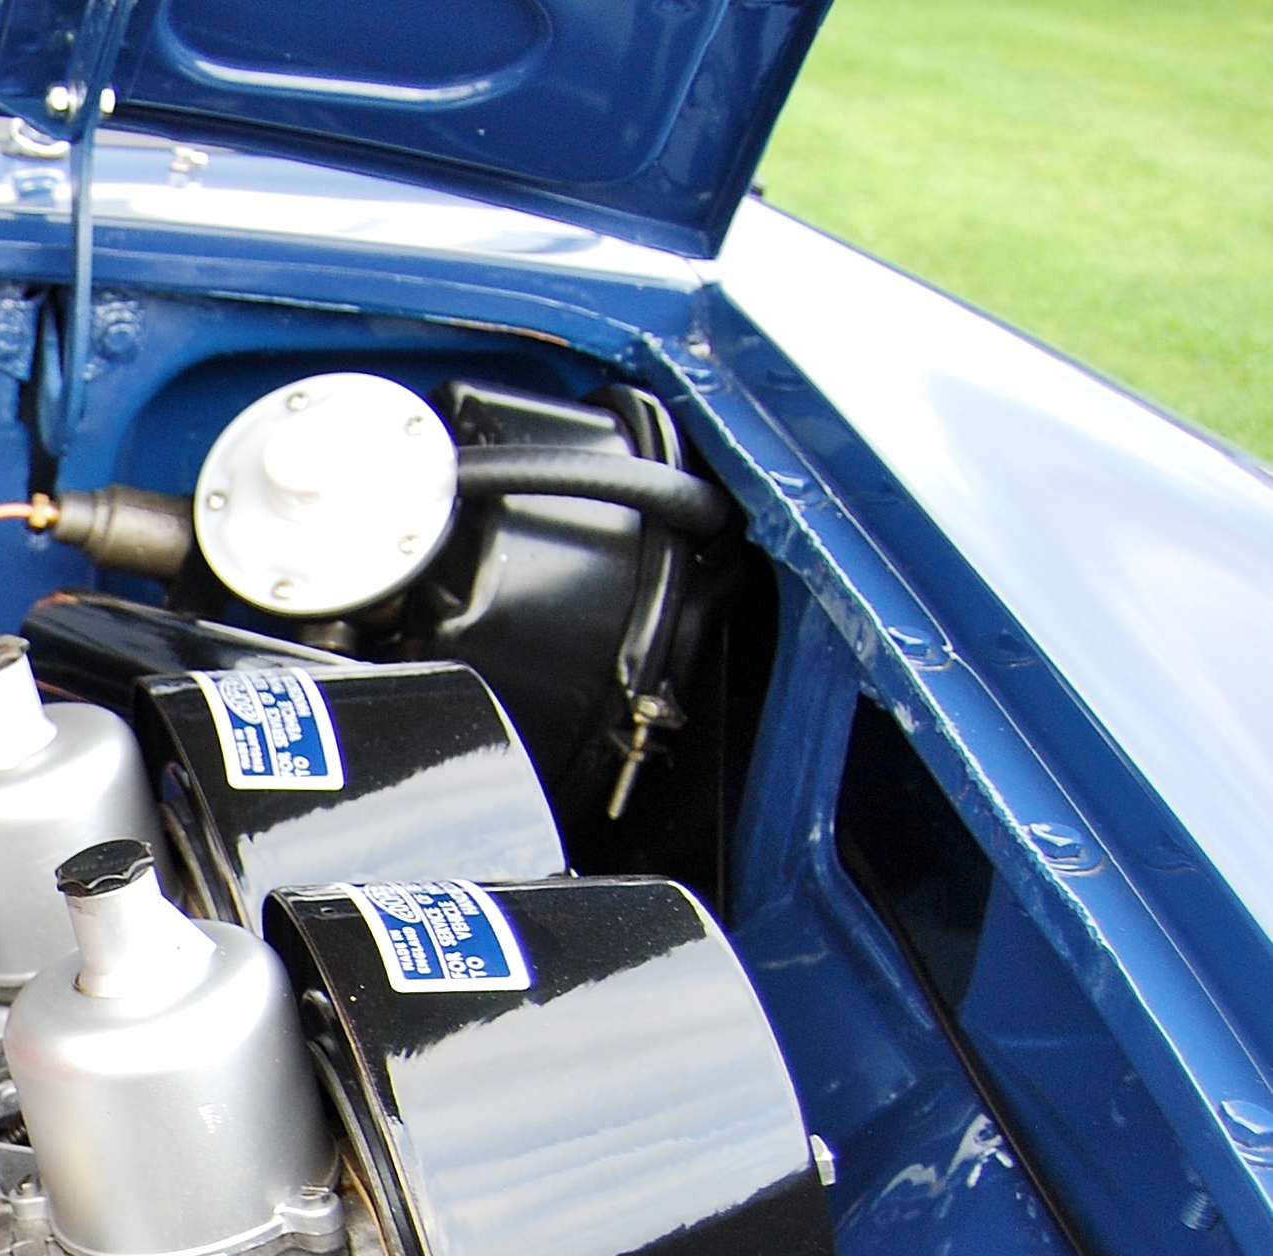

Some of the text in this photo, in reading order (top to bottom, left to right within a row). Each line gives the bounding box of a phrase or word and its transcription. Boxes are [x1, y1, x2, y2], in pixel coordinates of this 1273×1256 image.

[266, 706, 289, 748] SERVICE
[277, 699, 311, 777] TO VEHICLE
[413, 893, 434, 905] OF
[424, 906, 457, 948] SERVICE
[438, 900, 488, 979] TO VEHICLE
[402, 926, 431, 975] ENGLAND
[446, 951, 467, 979] FOR
